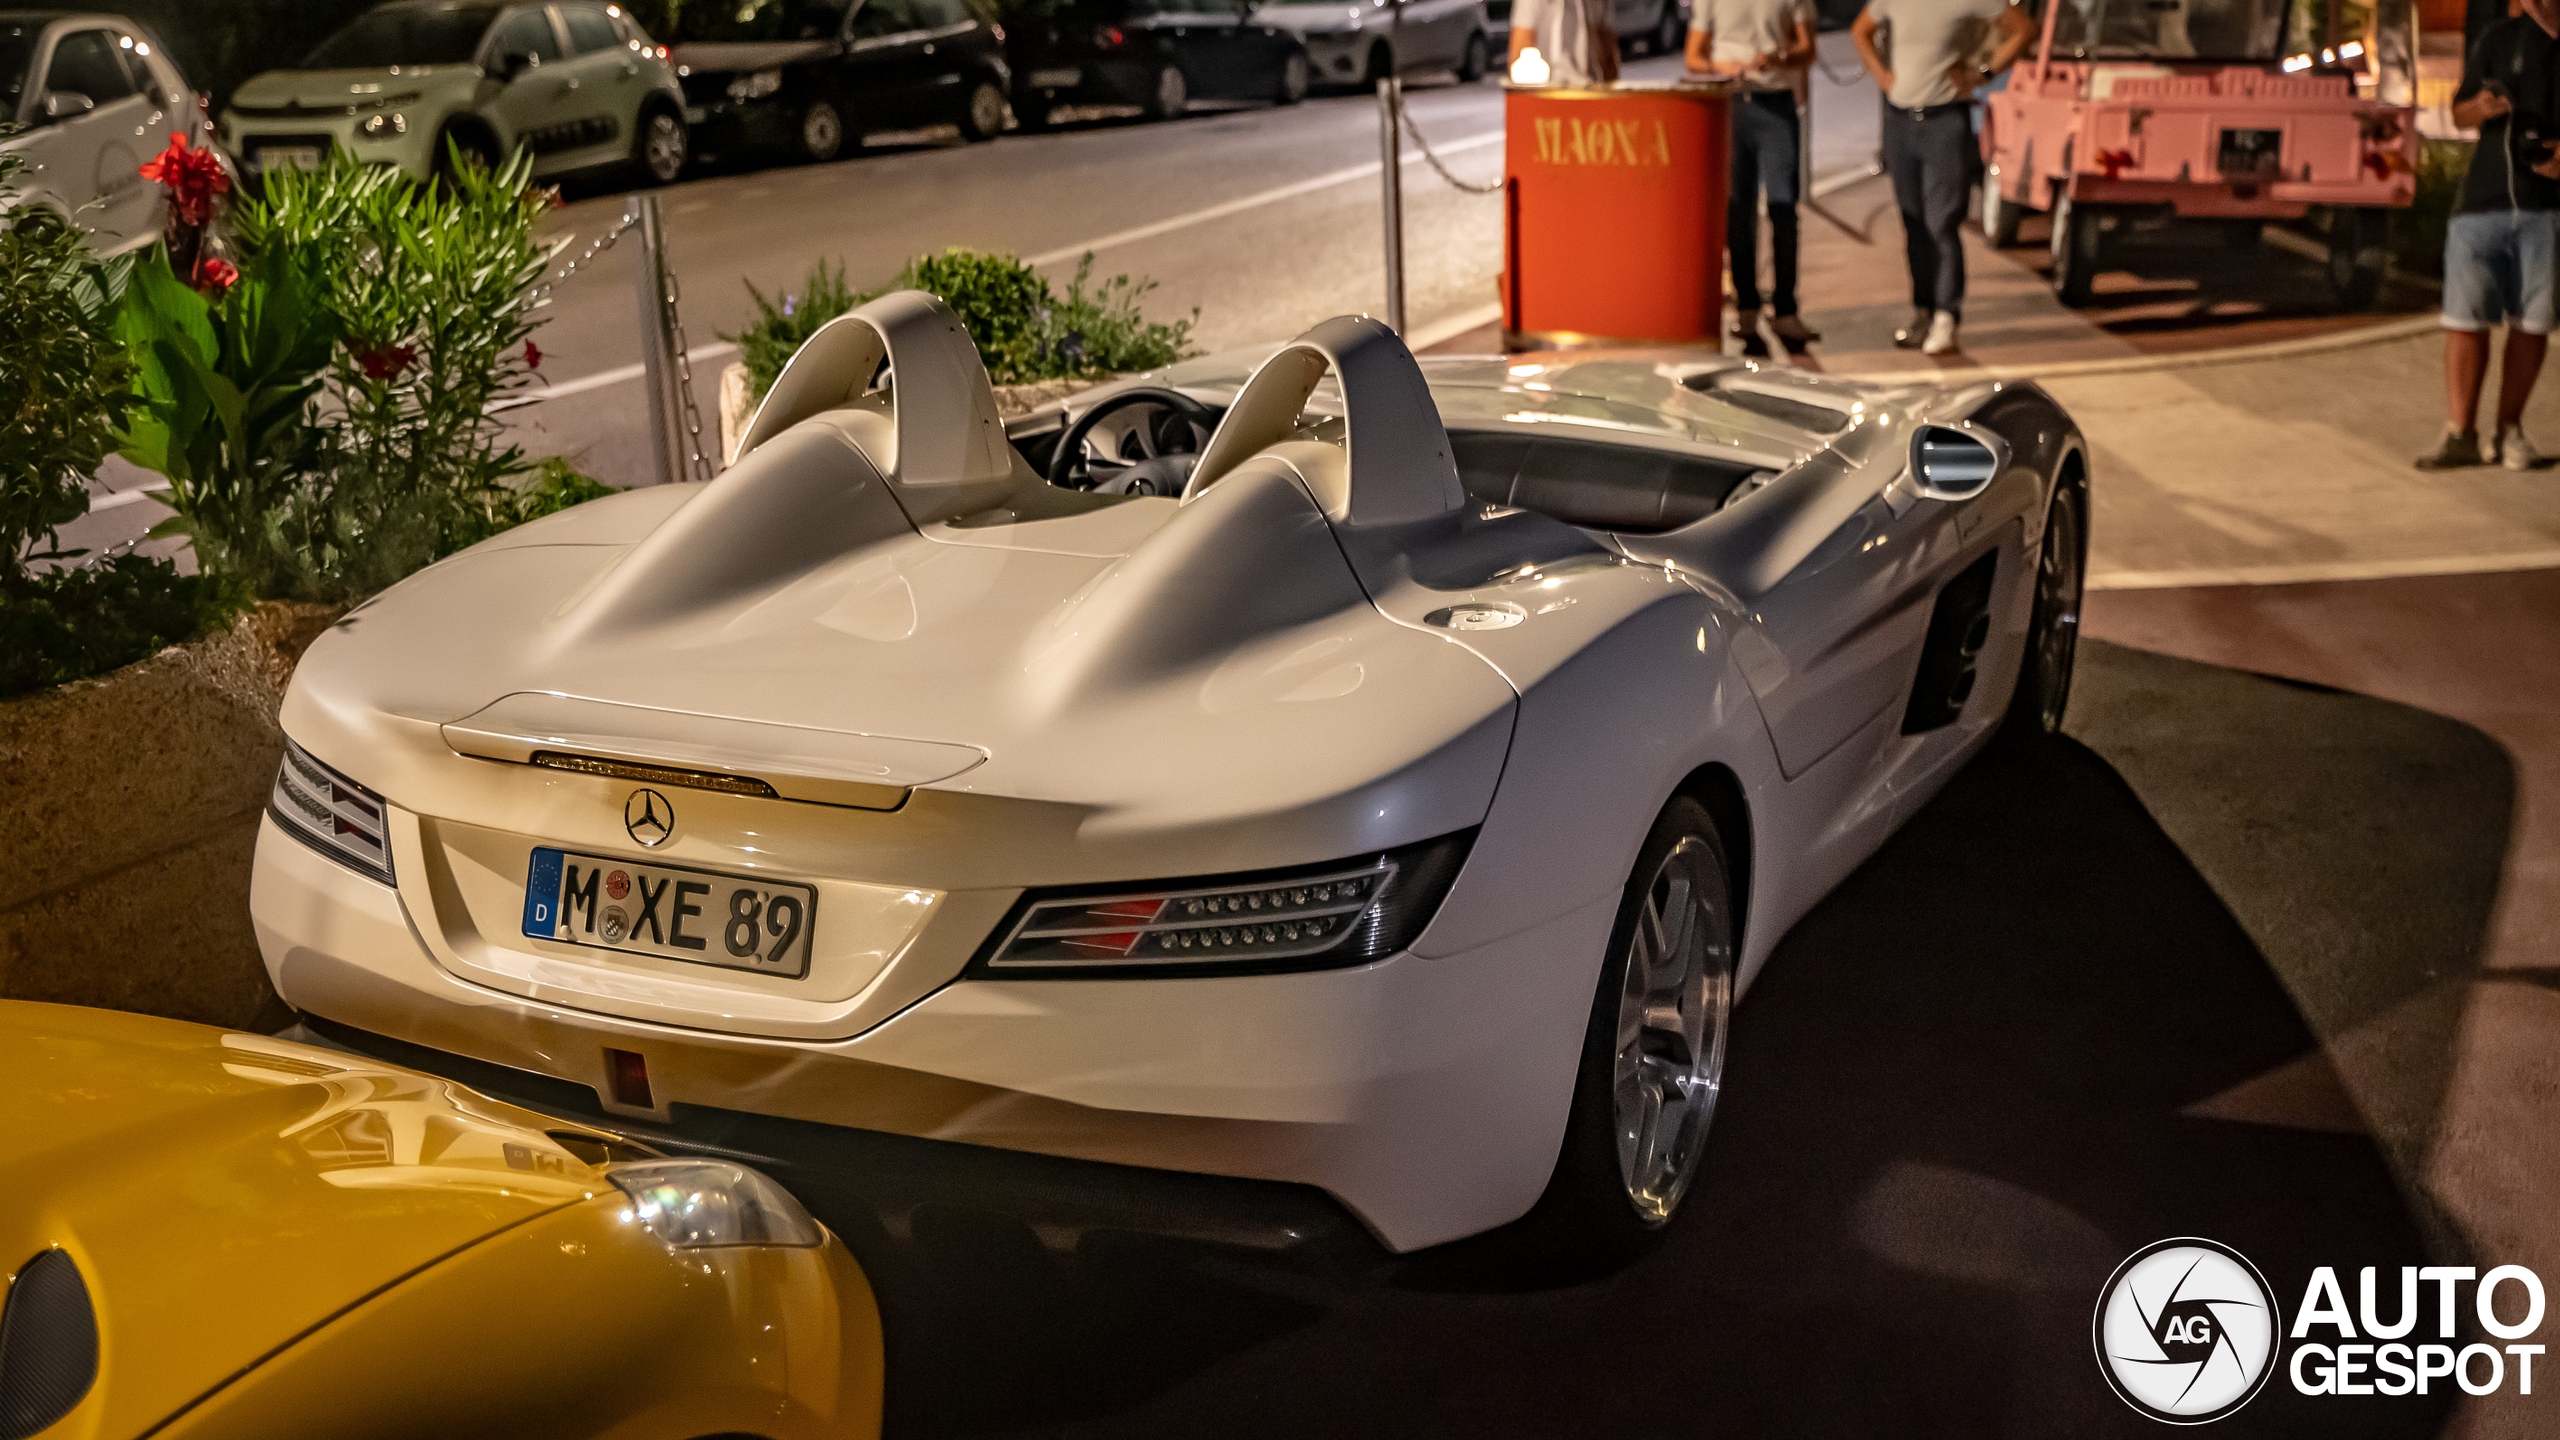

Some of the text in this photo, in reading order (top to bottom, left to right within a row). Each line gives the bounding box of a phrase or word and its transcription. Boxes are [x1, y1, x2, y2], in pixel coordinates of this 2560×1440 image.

[535, 903, 548, 922] D
[560, 865, 601, 933] M
[629, 875, 713, 951] XE
[725, 889, 804, 962] 89
